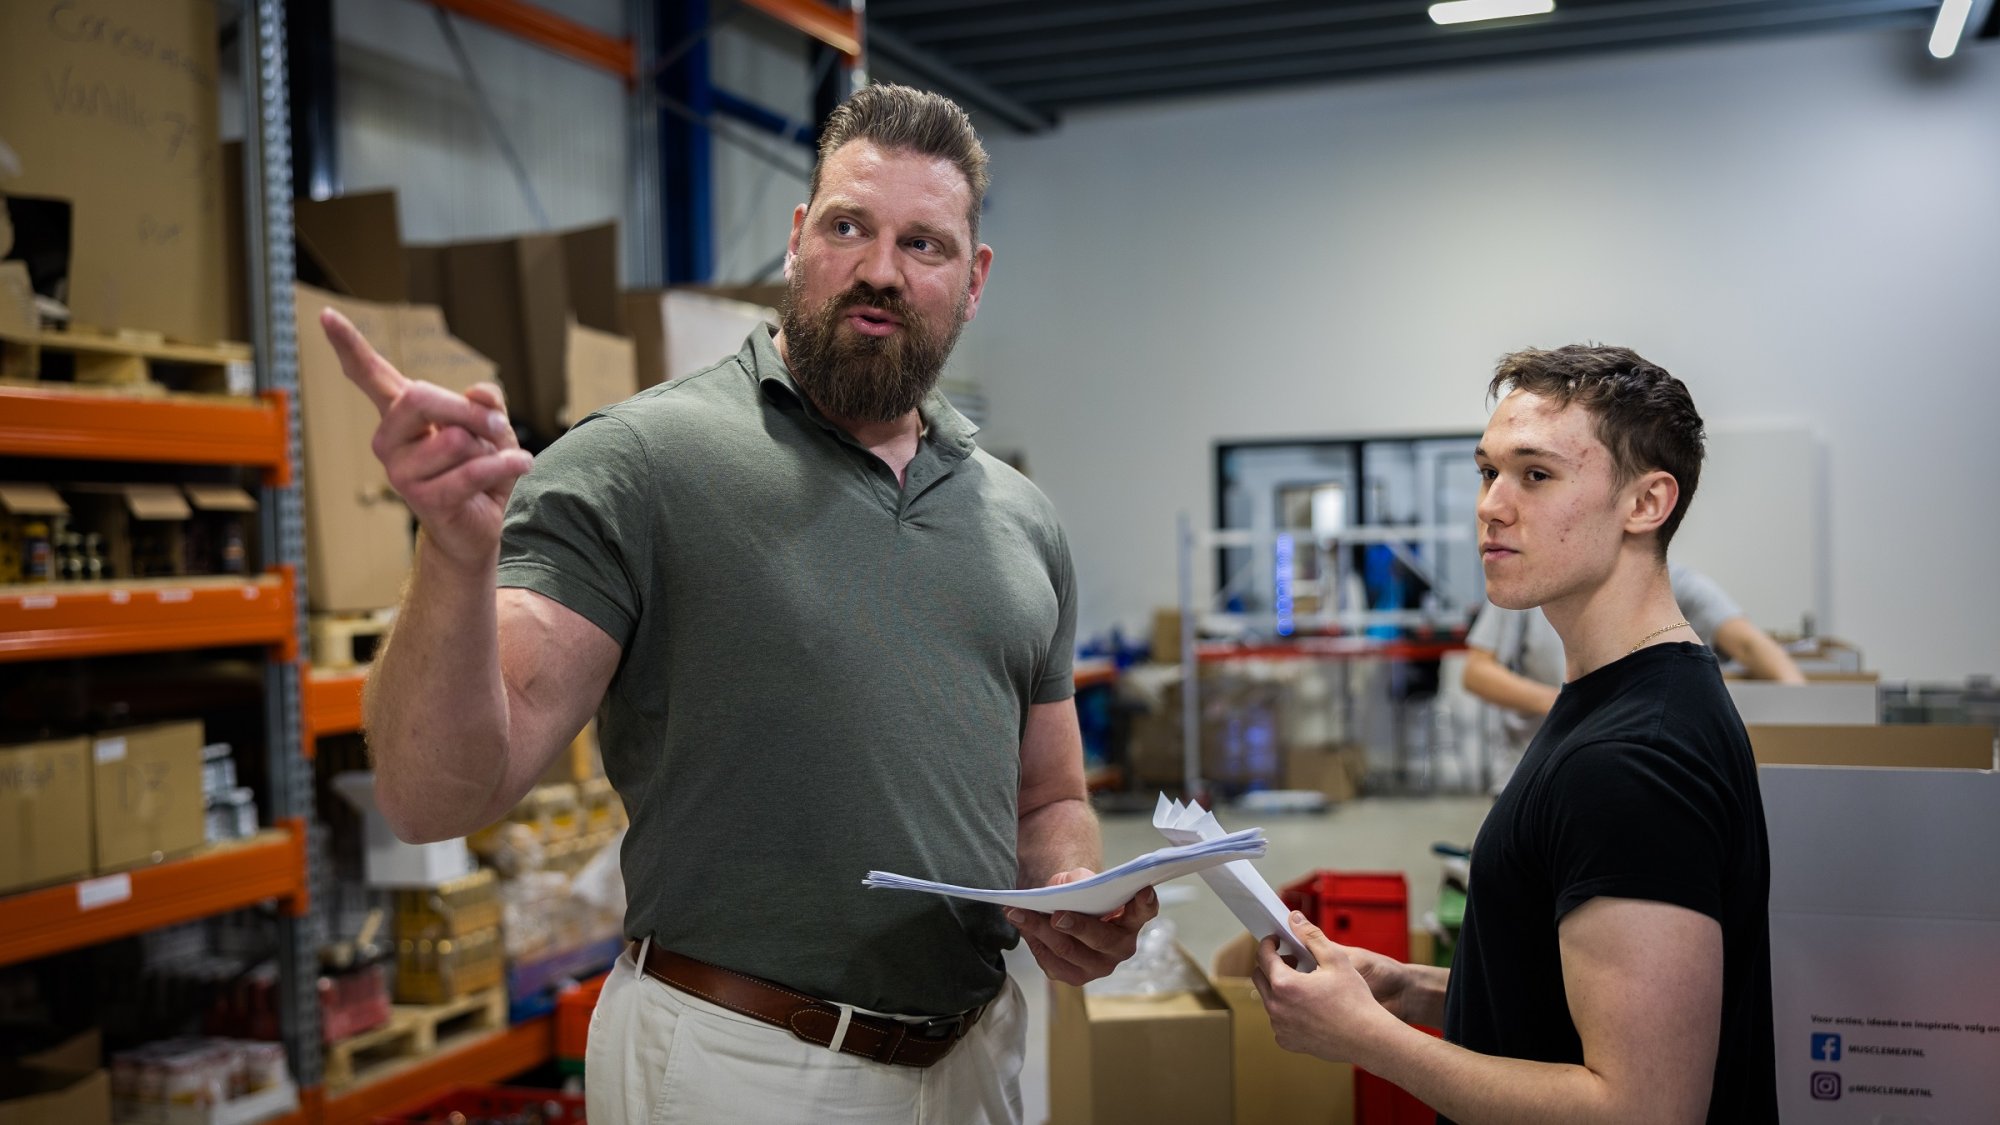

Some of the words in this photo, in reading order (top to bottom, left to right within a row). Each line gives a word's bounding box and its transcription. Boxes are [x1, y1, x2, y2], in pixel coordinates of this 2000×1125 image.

[1811, 1013, 1833, 1025] Voor
[1900, 1020, 1913, 1028] en
[1964, 1023, 1986, 1035] volg
[1848, 1045, 1925, 1058] MUSCLEMEATNL
[1848, 1084, 1933, 1098] @MUSCLEMEATNL
